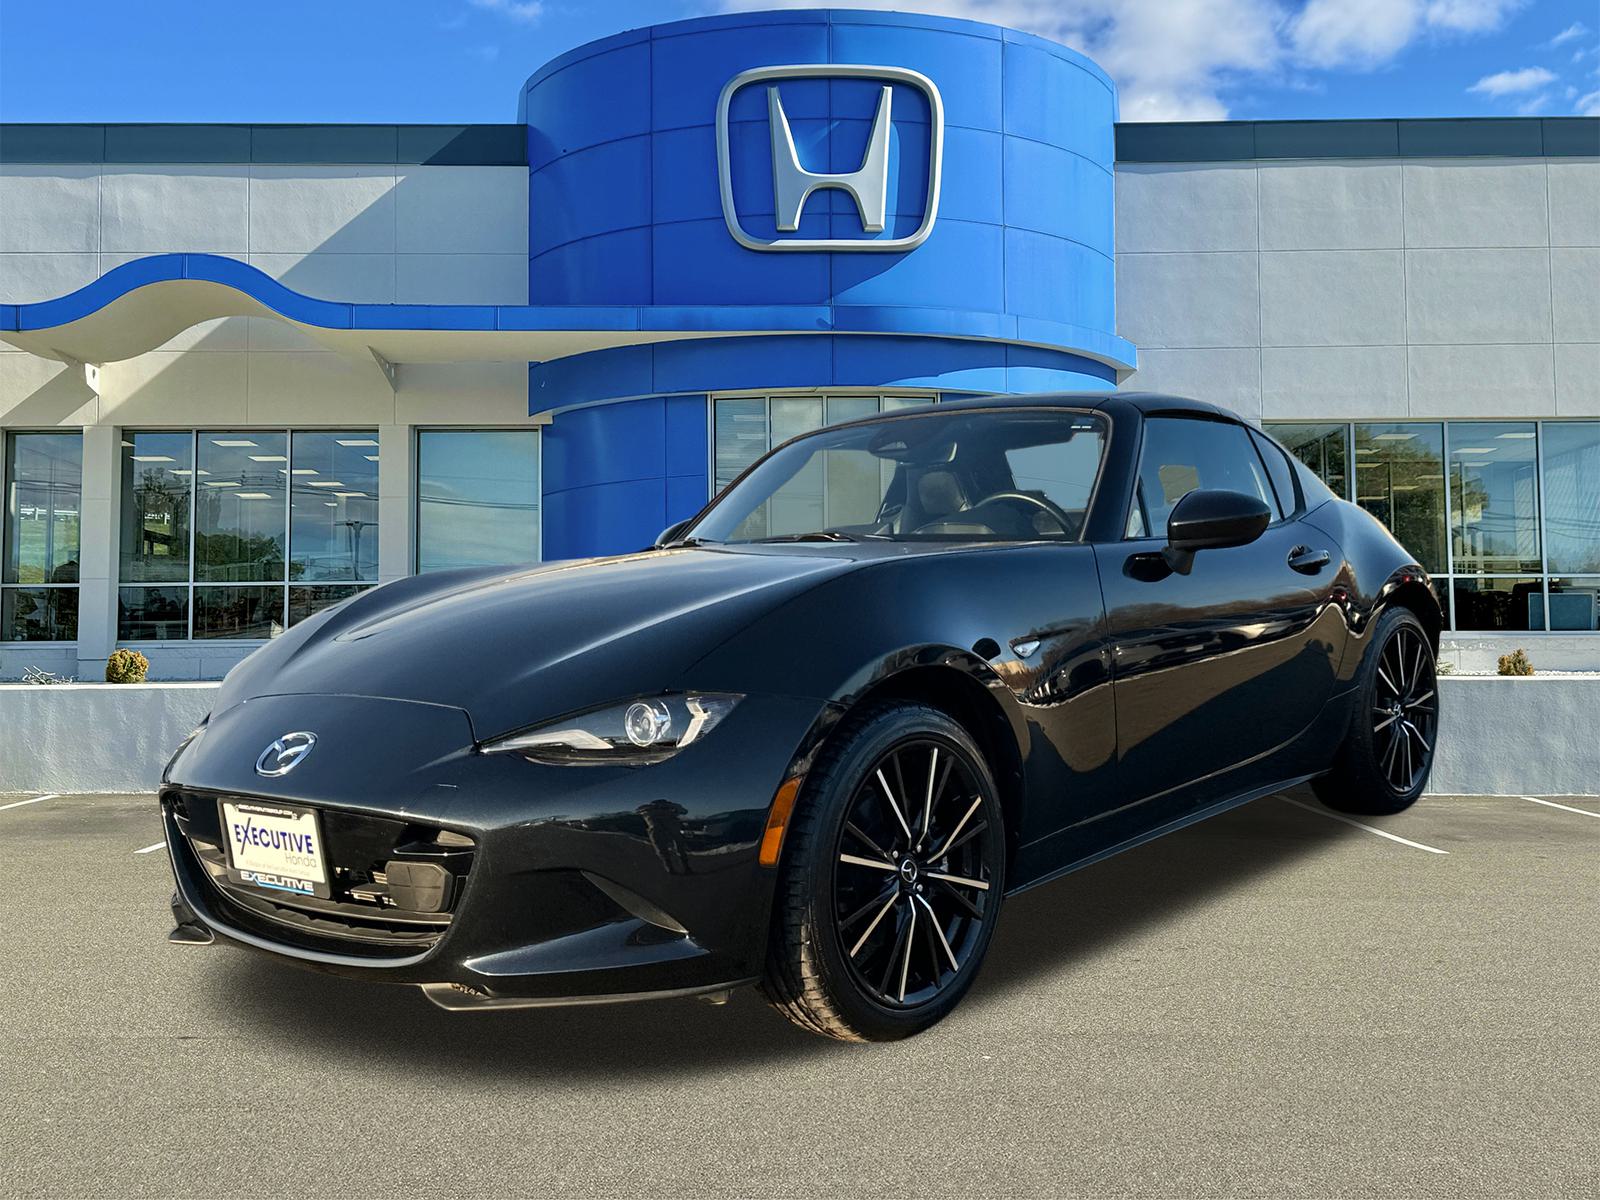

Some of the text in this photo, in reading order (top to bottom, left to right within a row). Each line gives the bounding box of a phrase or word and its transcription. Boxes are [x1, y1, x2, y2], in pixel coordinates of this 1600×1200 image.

[233, 817, 314, 855] EXECUTIVE
[285, 852, 317, 868] Honda
[240, 870, 314, 891] EXECUTIVE
